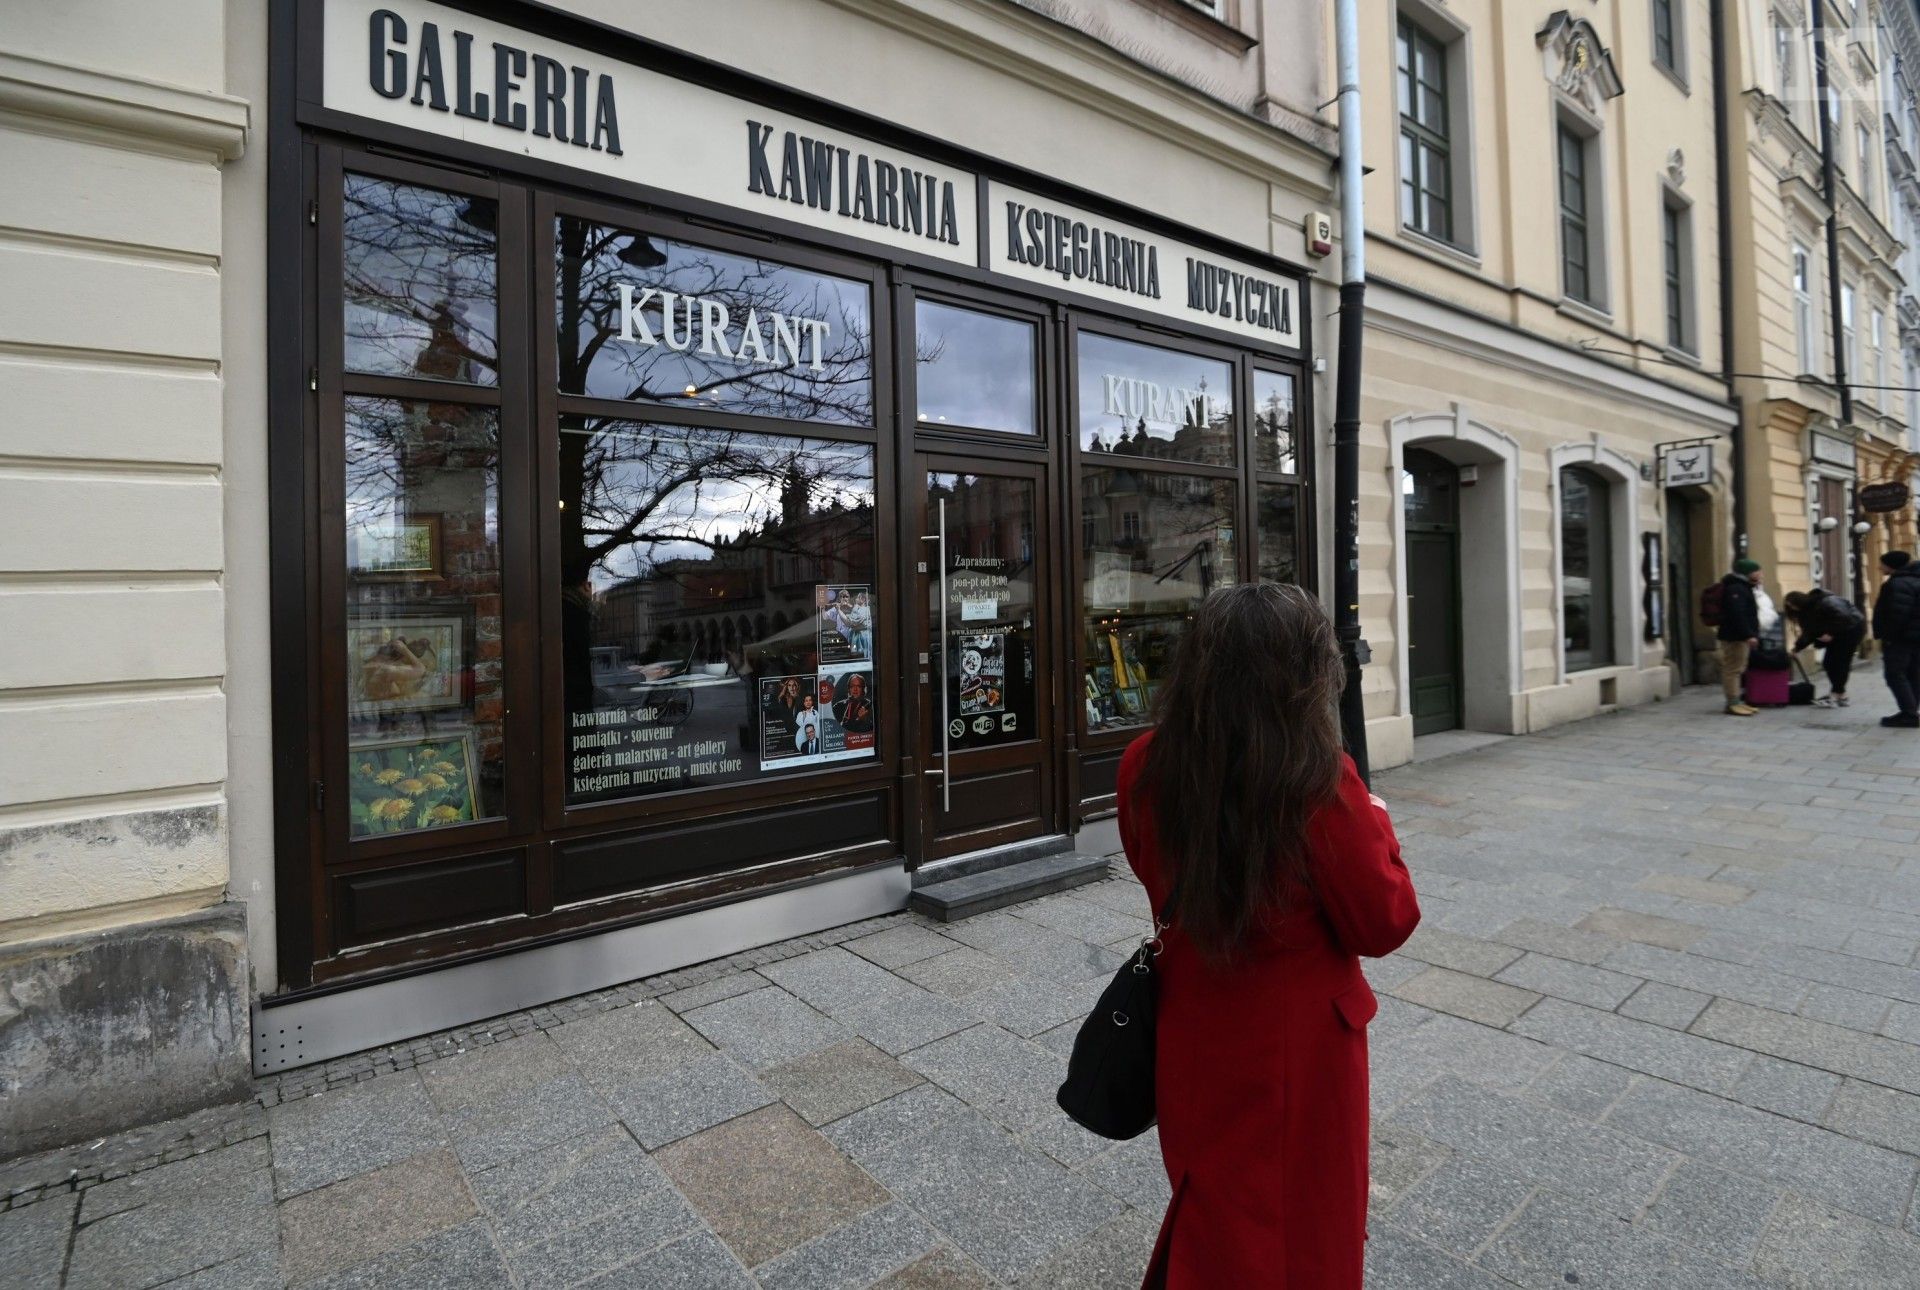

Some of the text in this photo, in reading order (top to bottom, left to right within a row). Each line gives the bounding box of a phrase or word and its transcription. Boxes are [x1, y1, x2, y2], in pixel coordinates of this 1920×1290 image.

[369, 9, 623, 156] GALERIA
[746, 120, 960, 245] KAWIARNIA
[1006, 200, 1292, 334] KSIĘGARNIA MUZYCZNA
[615, 282, 831, 372] KURANT
[1101, 373, 1214, 429] KURANT
[954, 554, 1005, 570] Zapraszamy:
[952, 577, 979, 590] pon-pt
[980, 575, 990, 587] od
[572, 708, 627, 728] kawiarnia
[573, 730, 621, 751] pamiątki
[631, 726, 674, 744] souvenir
[573, 753, 612, 773] galeria
[615, 747, 668, 766] malarstwa
[677, 743, 692, 759] art
[694, 740, 727, 758] gallery
[574, 771, 630, 793] księgarnia
[633, 765, 681, 784] muzyczna
[690, 760, 717, 777] music
[719, 758, 742, 773] store
